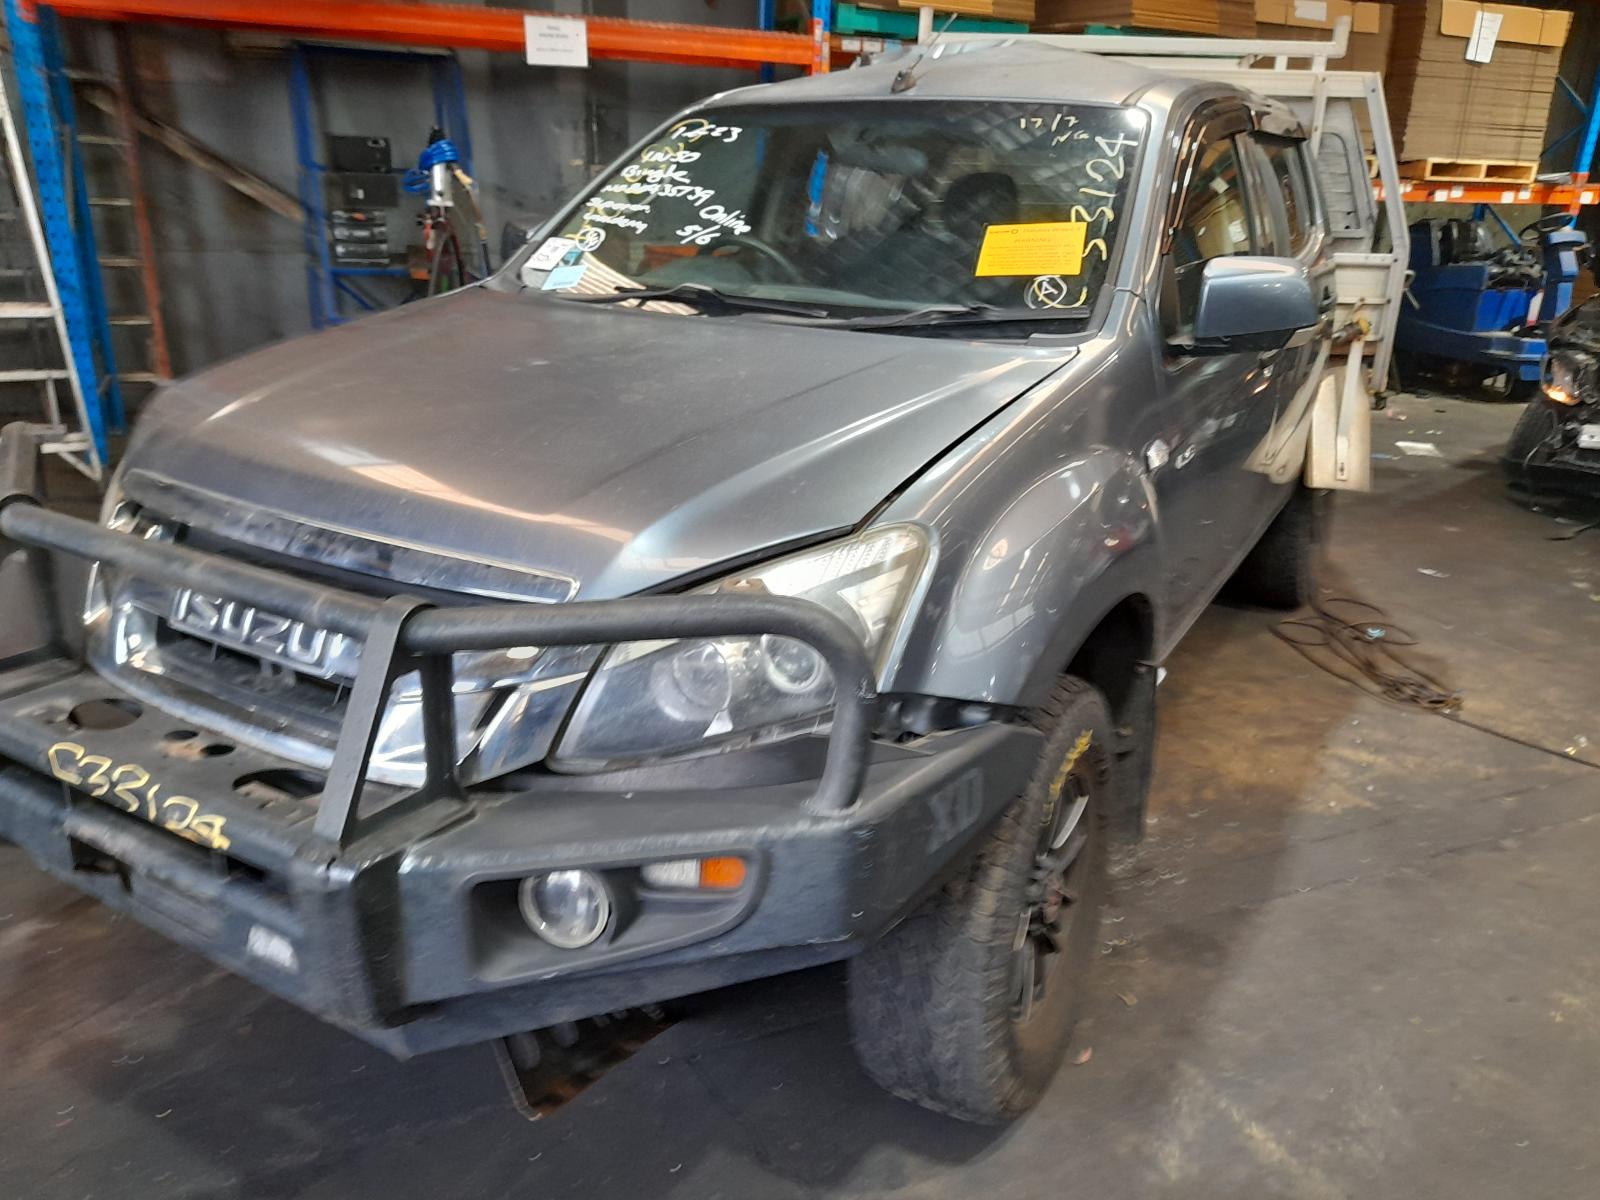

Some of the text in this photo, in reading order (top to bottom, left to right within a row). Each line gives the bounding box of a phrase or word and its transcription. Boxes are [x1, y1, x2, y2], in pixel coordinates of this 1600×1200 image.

[675, 224, 722, 245] 5/6
[699, 204, 752, 236] Online
[171, 587, 329, 665] ISUZU
